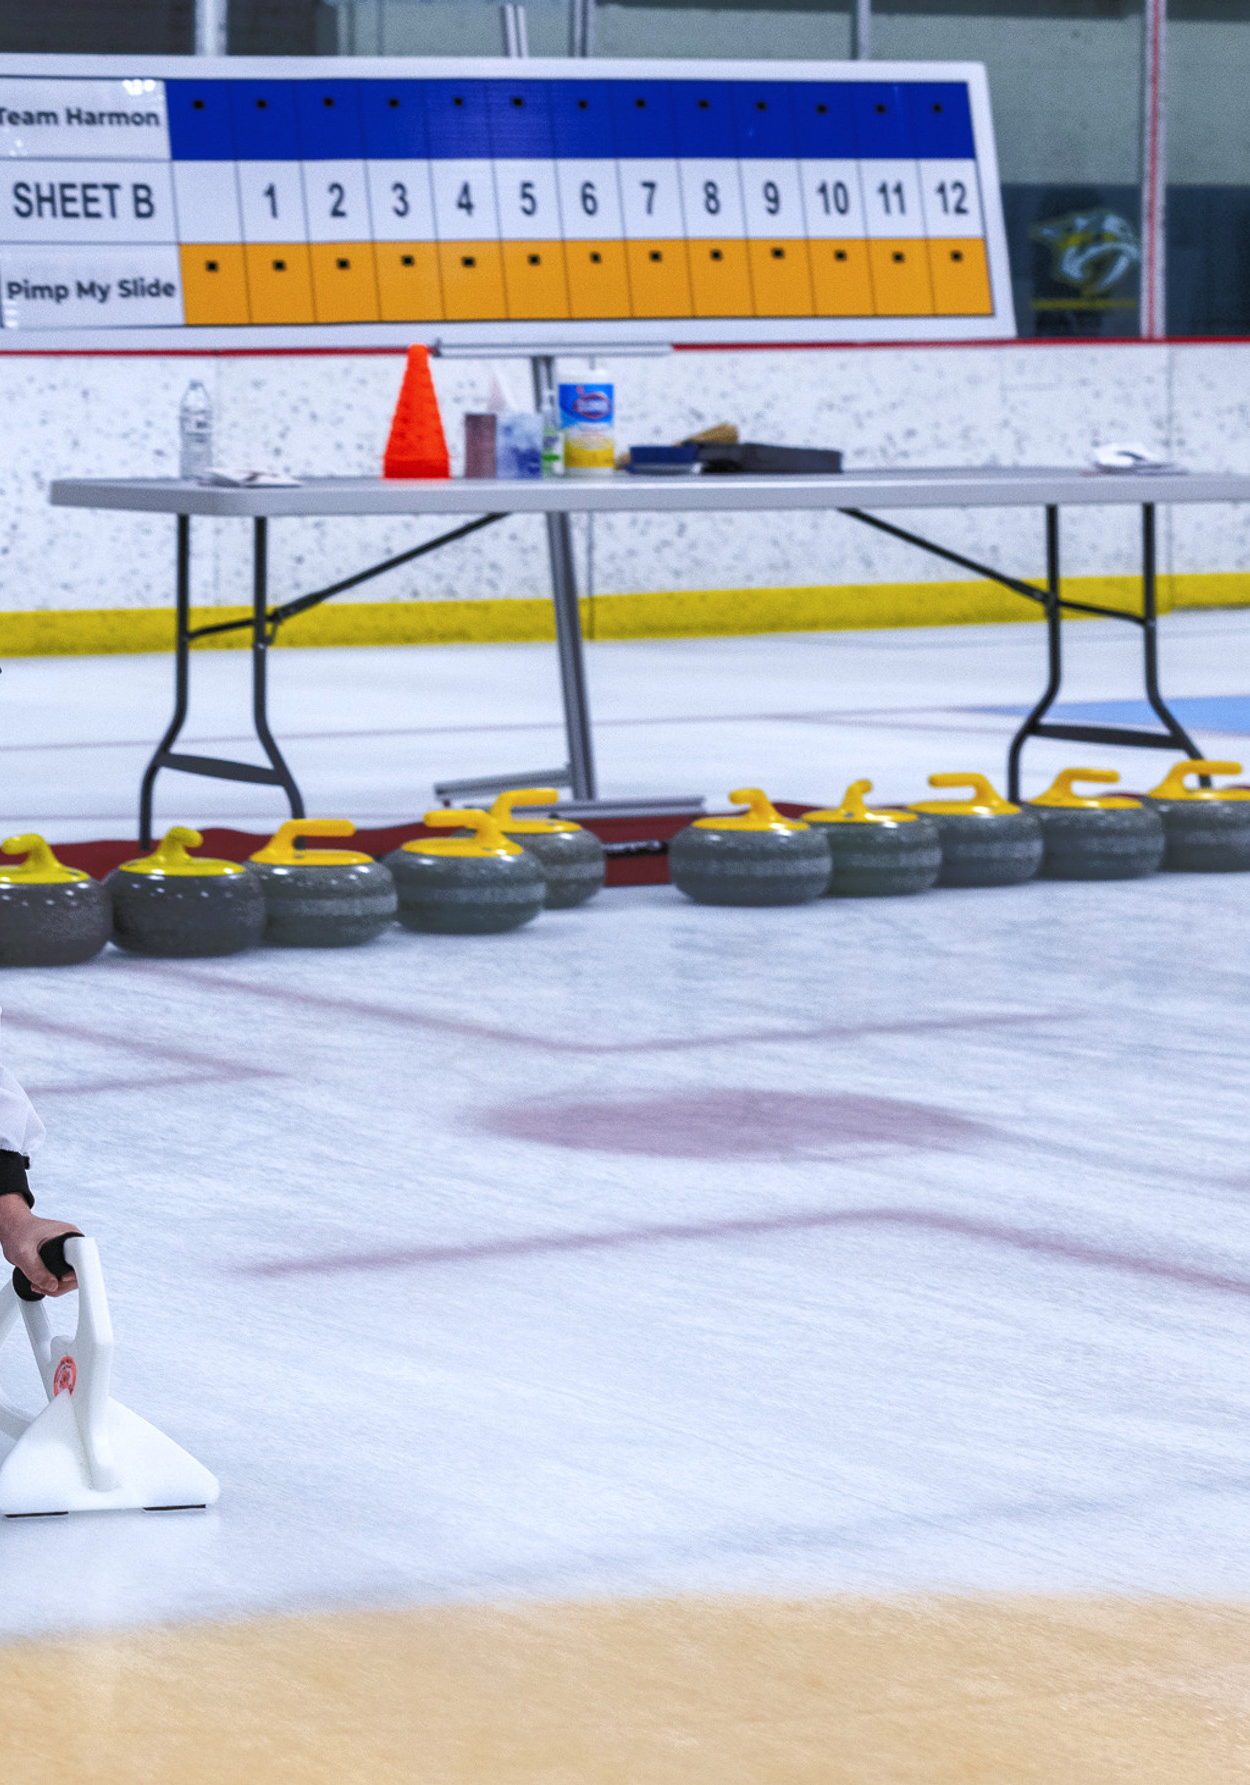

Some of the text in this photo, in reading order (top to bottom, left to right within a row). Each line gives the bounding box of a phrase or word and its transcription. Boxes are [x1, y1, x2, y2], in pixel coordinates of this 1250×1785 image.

[66, 107, 160, 127] Harmon
[13, 180, 969, 219] SHEET B 1 2 3 4 5 6 7 8 9 10 11 12
[6, 277, 176, 304] Pimp My Slide
